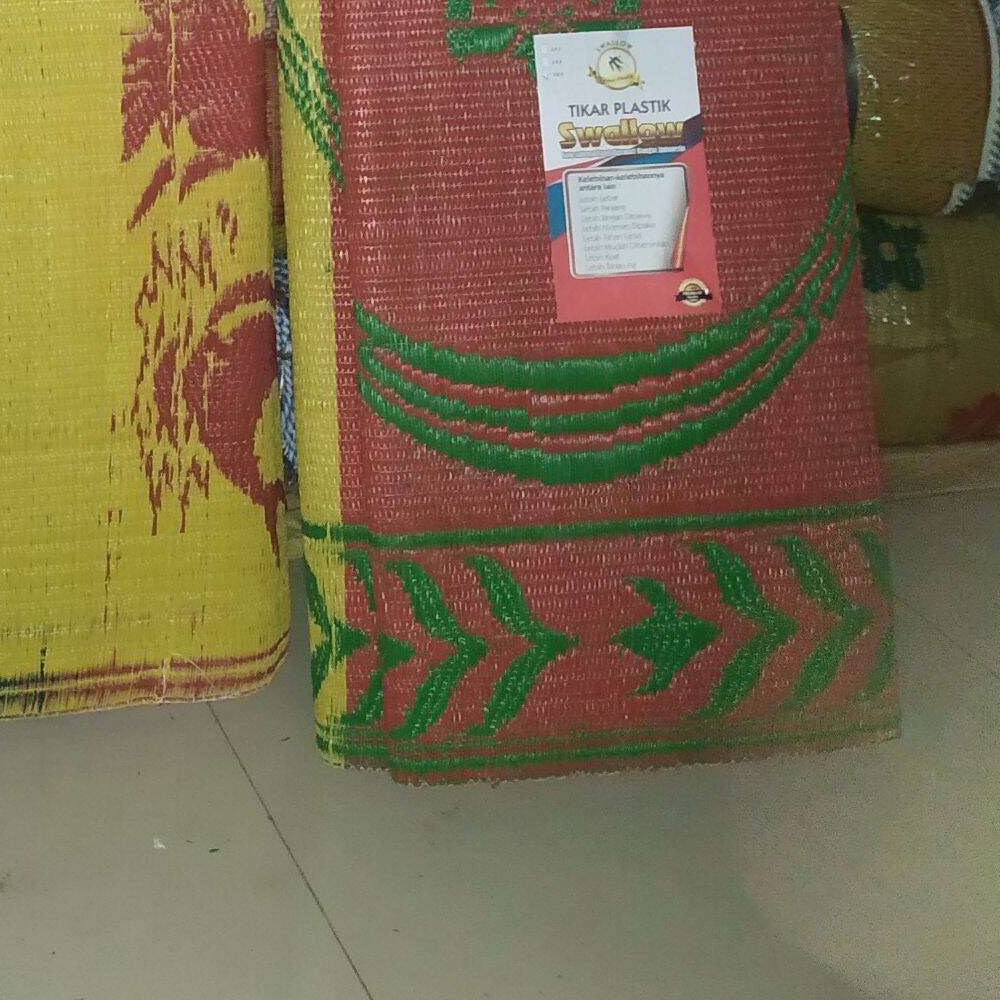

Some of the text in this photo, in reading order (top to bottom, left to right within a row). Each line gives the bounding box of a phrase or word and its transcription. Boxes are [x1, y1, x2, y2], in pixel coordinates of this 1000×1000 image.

[568, 100, 672, 118] TIKAR PLASTIK
[557, 117, 685, 149] Swallow
